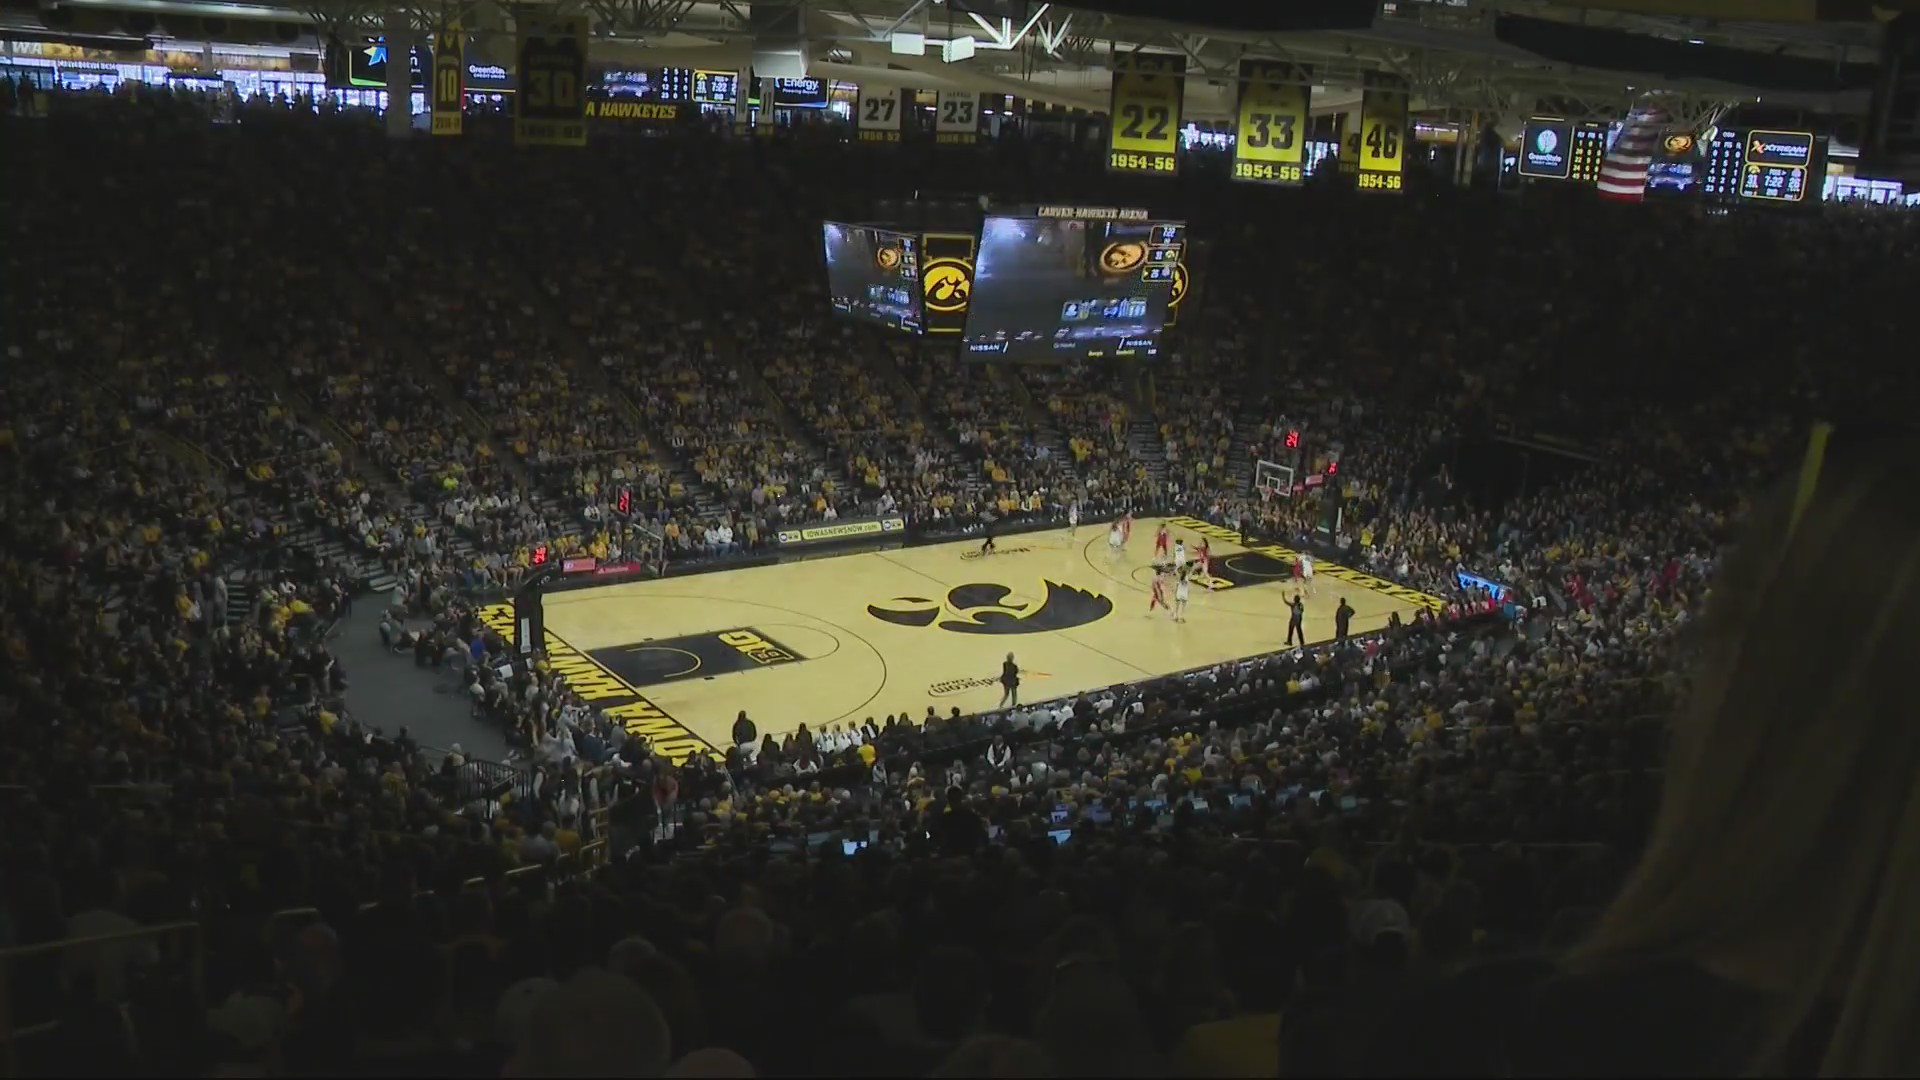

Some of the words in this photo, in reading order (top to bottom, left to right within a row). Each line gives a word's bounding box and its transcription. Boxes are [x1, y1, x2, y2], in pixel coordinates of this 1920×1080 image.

[527, 71, 578, 107] 30
[711, 82, 727, 92] 7:22
[783, 78, 819, 90] Energy
[600, 102, 677, 119] HAWKEYES
[865, 98, 896, 122] 27
[943, 101, 974, 123] 23
[1120, 104, 1169, 140] 22
[1248, 113, 1296, 149] 33
[1366, 124, 1398, 159] 46
[1111, 153, 1176, 172] 1954-56
[1235, 163, 1301, 181] 1954-56
[1358, 173, 1401, 189] 1954-56
[1764, 175, 1784, 188] 7:22
